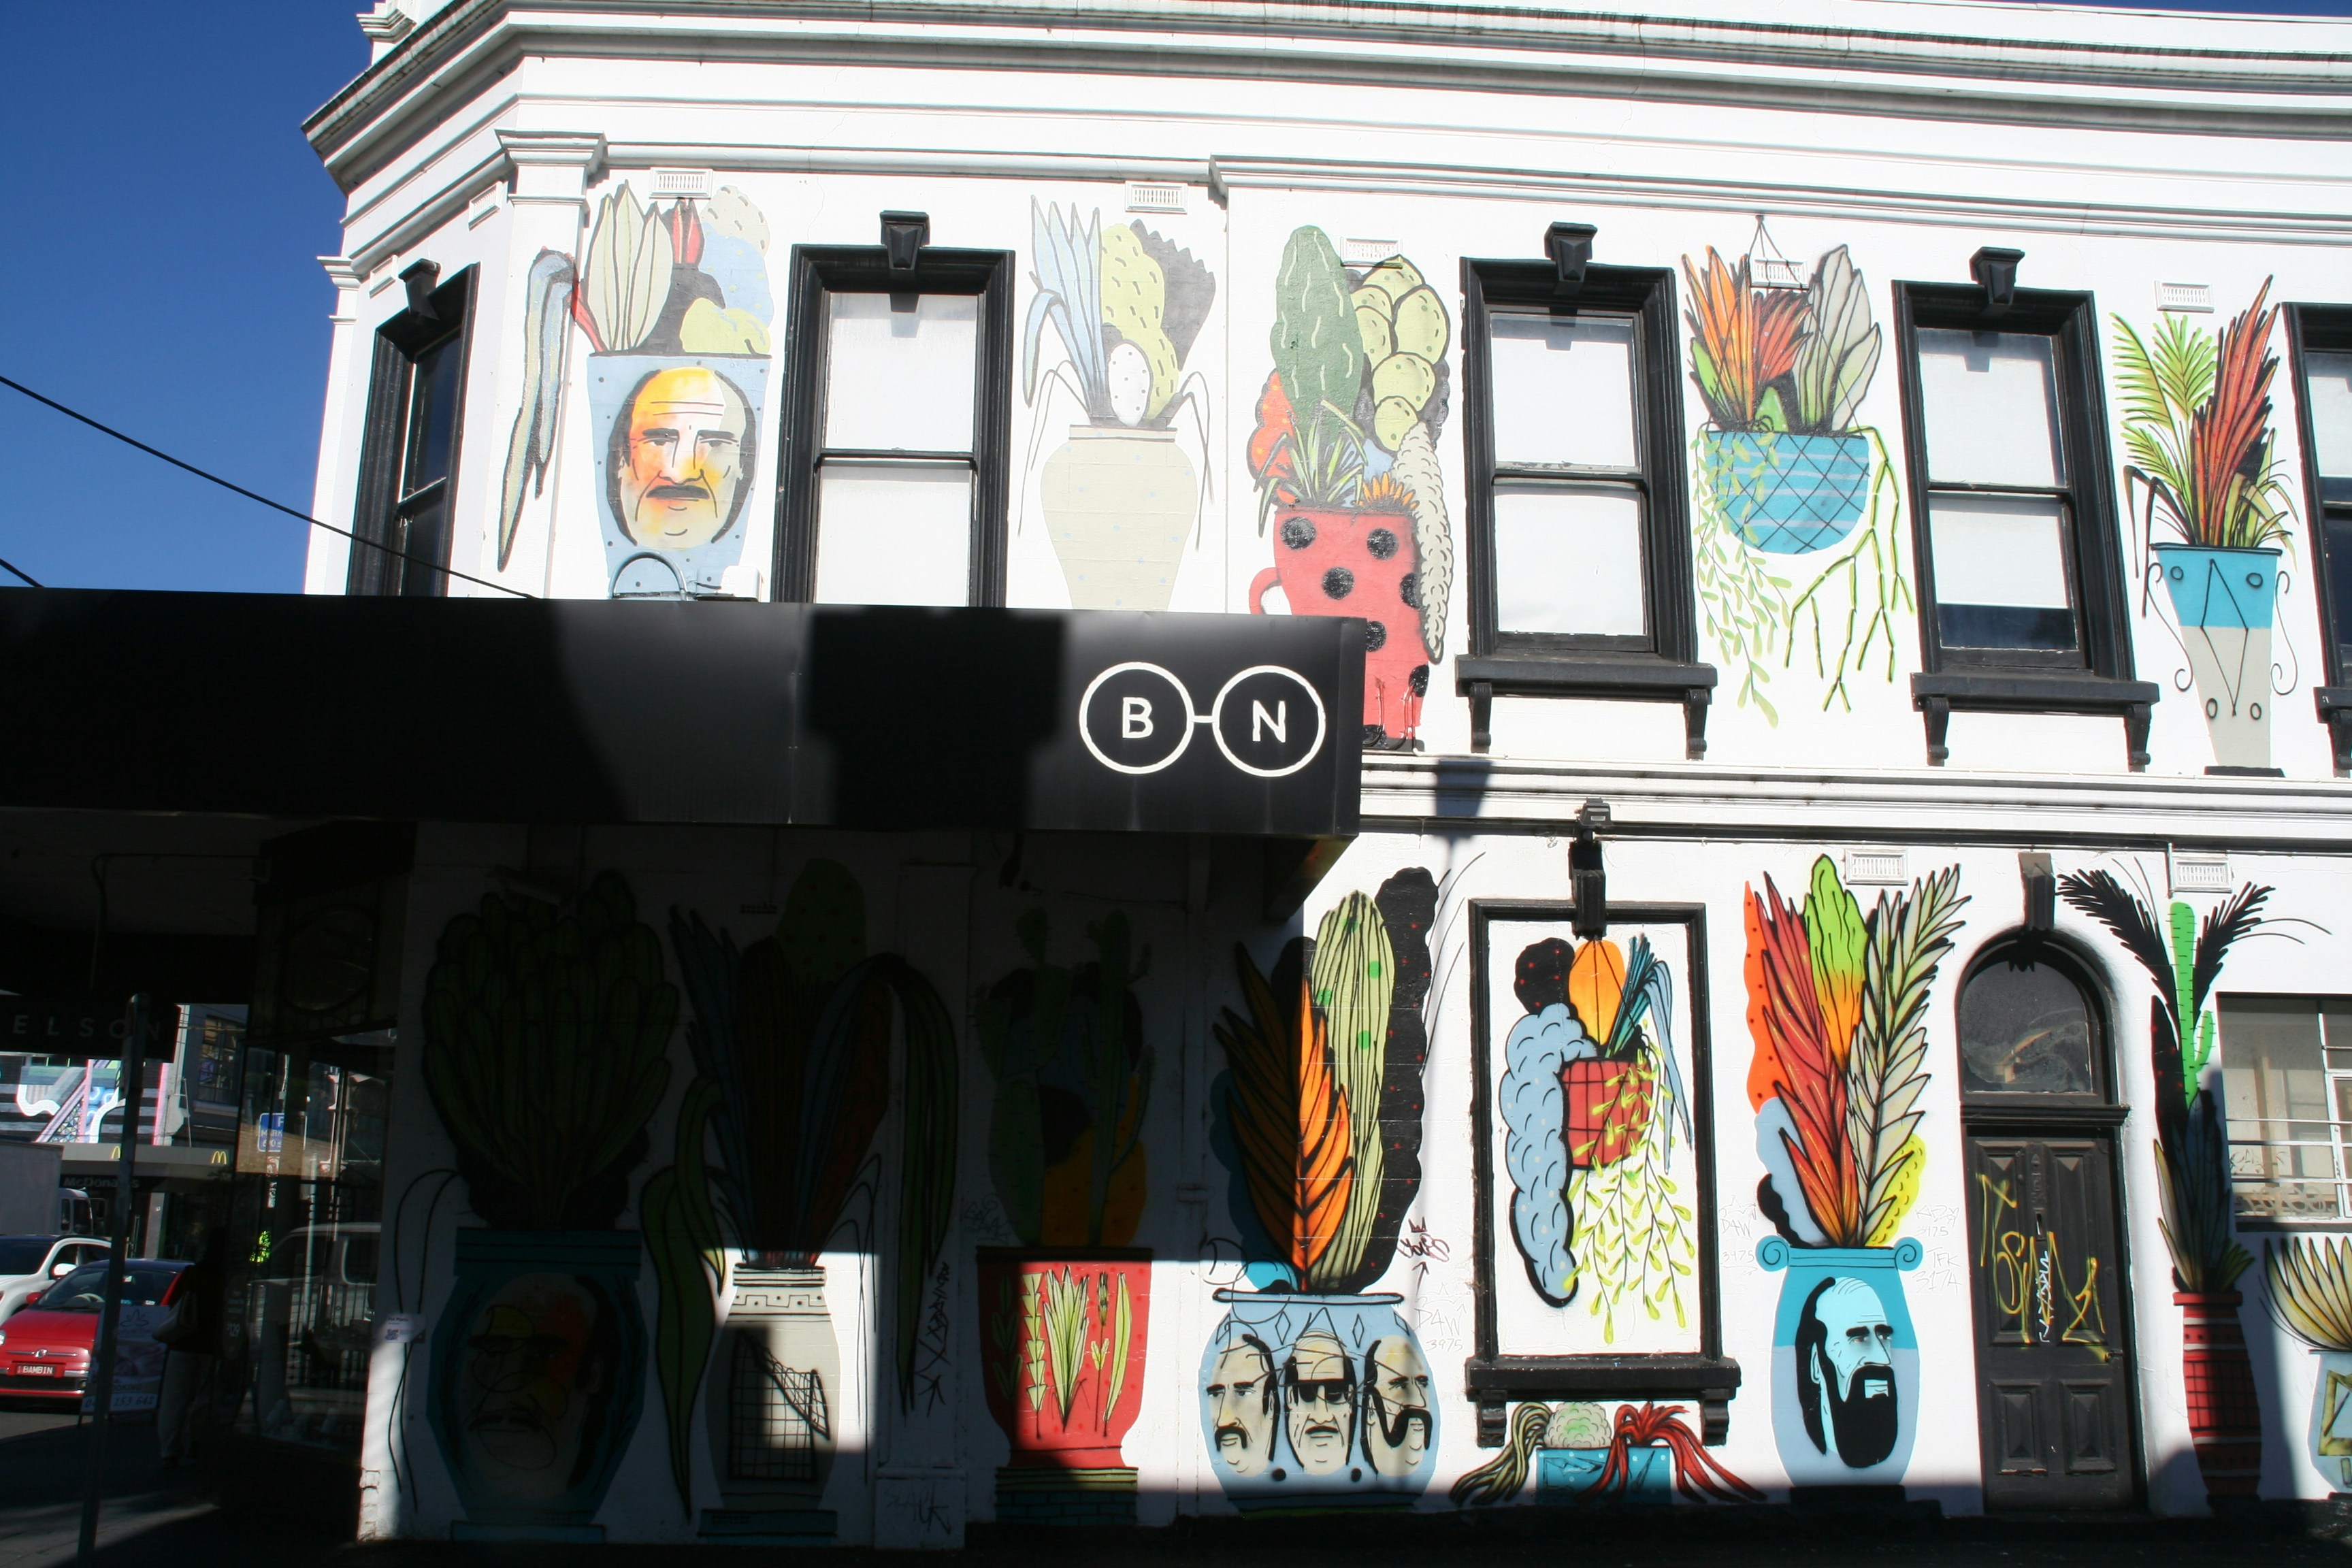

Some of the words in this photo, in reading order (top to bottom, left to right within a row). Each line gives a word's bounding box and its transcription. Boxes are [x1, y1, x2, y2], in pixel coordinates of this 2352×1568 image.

[1122, 696, 1154, 738] B
[1253, 700, 1286, 742] N
[63, 1175, 141, 1190] McDonas
